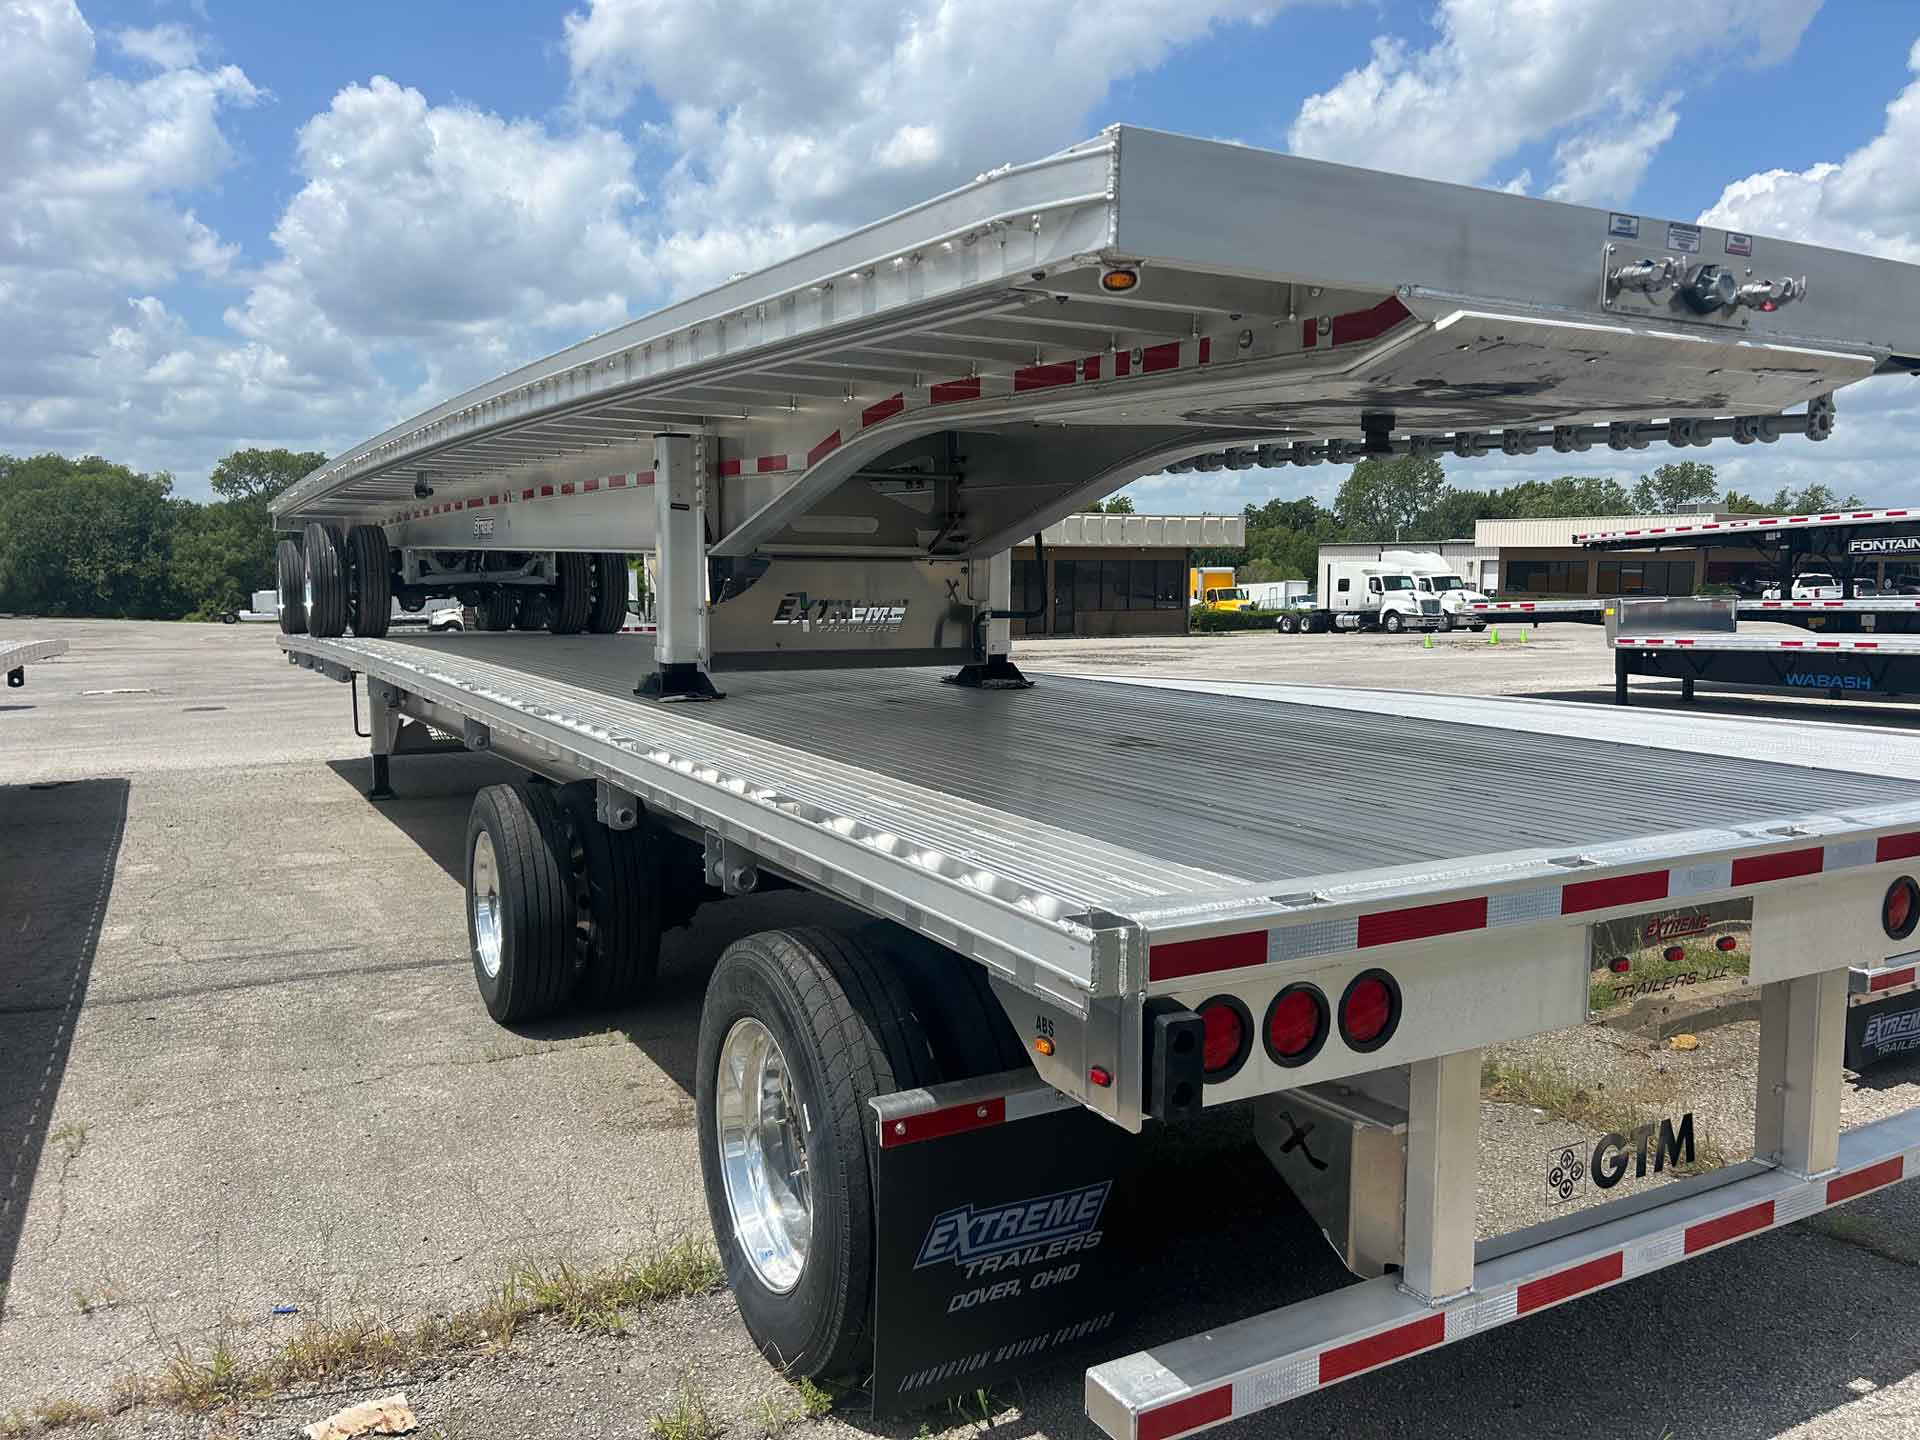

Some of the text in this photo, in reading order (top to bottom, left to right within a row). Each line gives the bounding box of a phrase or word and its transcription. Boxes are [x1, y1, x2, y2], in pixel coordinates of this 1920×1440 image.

[1785, 673, 1872, 688] WABASH
[1646, 914, 1710, 943] EXTREME
[1613, 966, 1729, 1000] TRAILERS LLC
[1035, 1014, 1055, 1037] ABS
[1591, 1113, 1695, 1189] GTM
[921, 1188, 1105, 1258] EXTREME
[964, 1231, 1103, 1280] TRAILERS
[948, 1264, 1081, 1313] DOVER, OHIO
